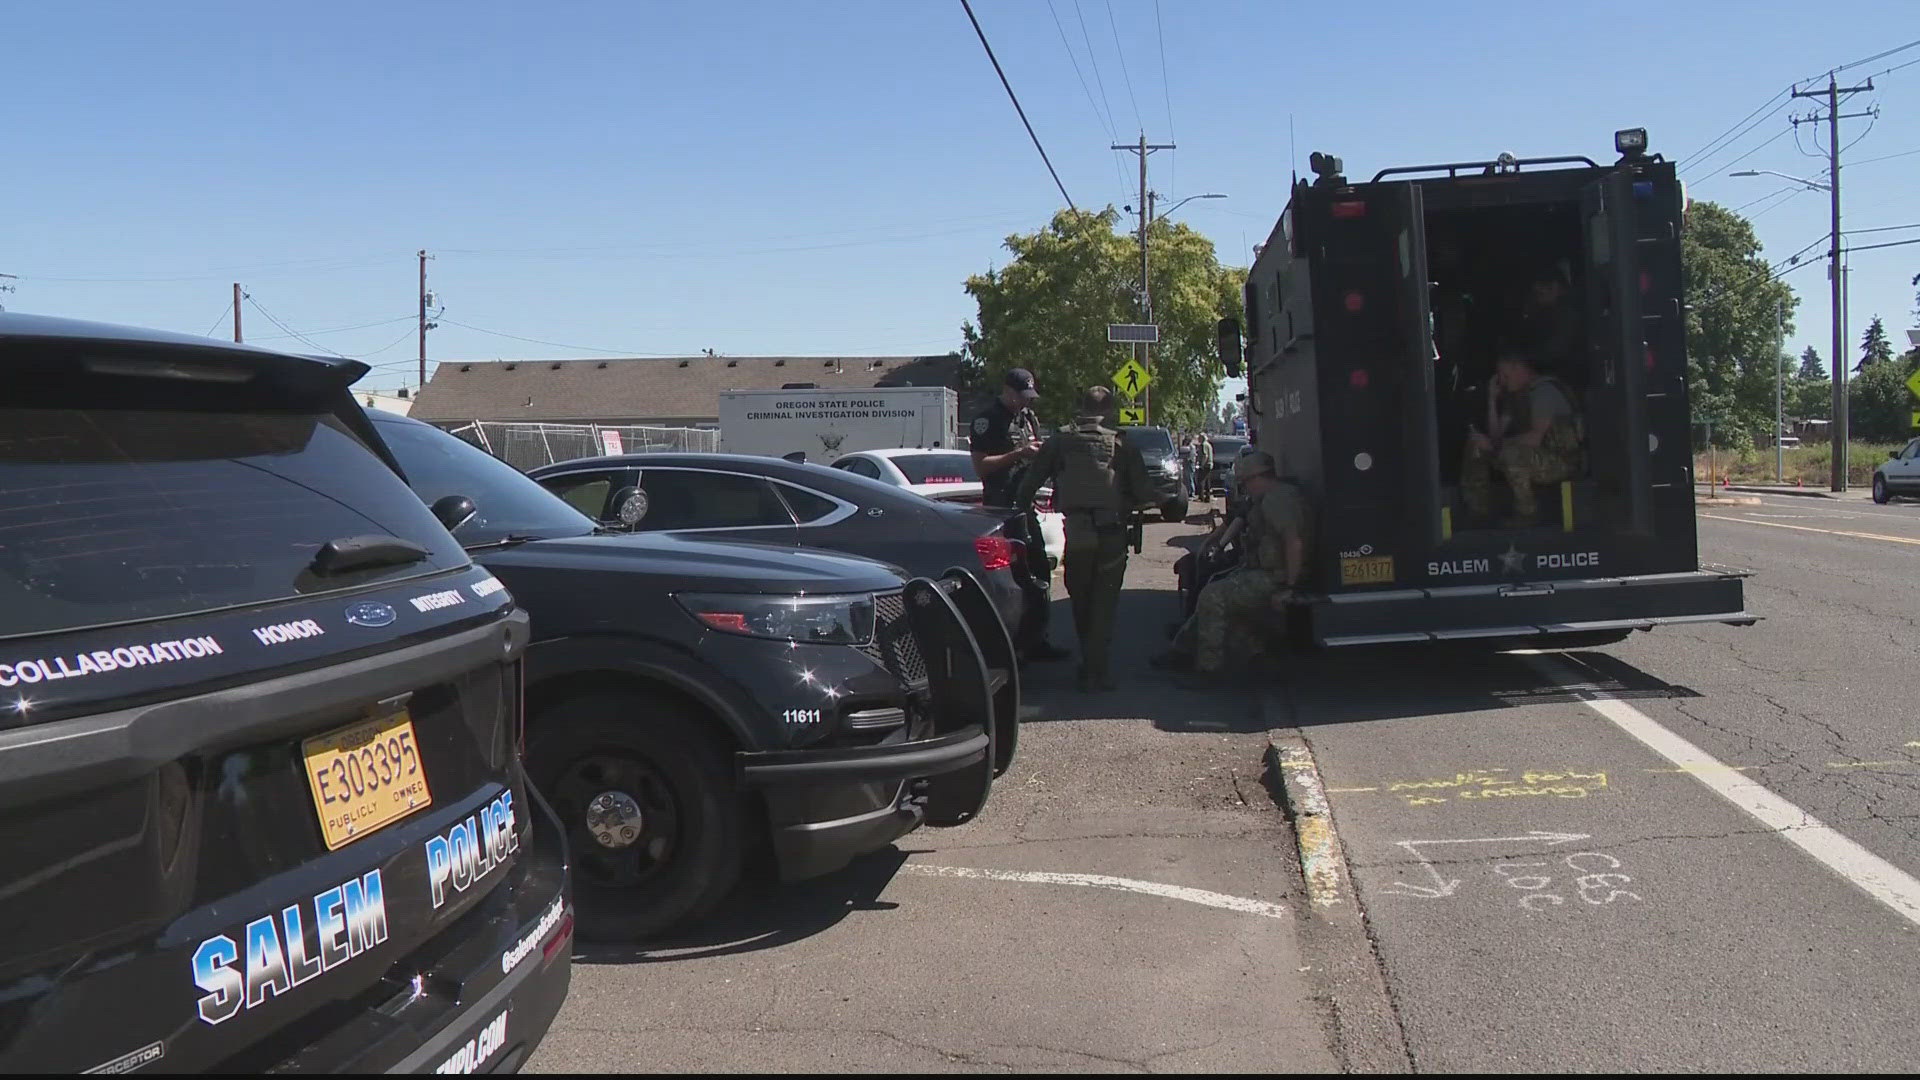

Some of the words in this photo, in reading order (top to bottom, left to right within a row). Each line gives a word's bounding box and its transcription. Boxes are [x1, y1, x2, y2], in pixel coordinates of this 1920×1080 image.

[747, 411, 793, 420] CRIMINAL
[795, 410, 870, 419] INVESTIGATION
[872, 409, 915, 418] DIVISION
[775, 400, 816, 410] OREGON
[818, 400, 848, 409] STATE
[850, 399, 886, 409] POLICE
[1428, 558, 1490, 576] SALEM
[1536, 552, 1600, 569] POLICE
[0, 635, 225, 687] COLLABORATION
[252, 619, 325, 646] HONOR
[409, 589, 466, 613] INTEGRITY
[782, 708, 821, 723] 11611
[317, 731, 417, 806] E303395
[328, 801, 379, 831] PUBLICLY
[393, 780, 424, 802] OWNED
[192, 868, 389, 1026] SALEM
[425, 789, 519, 909] POLICE
